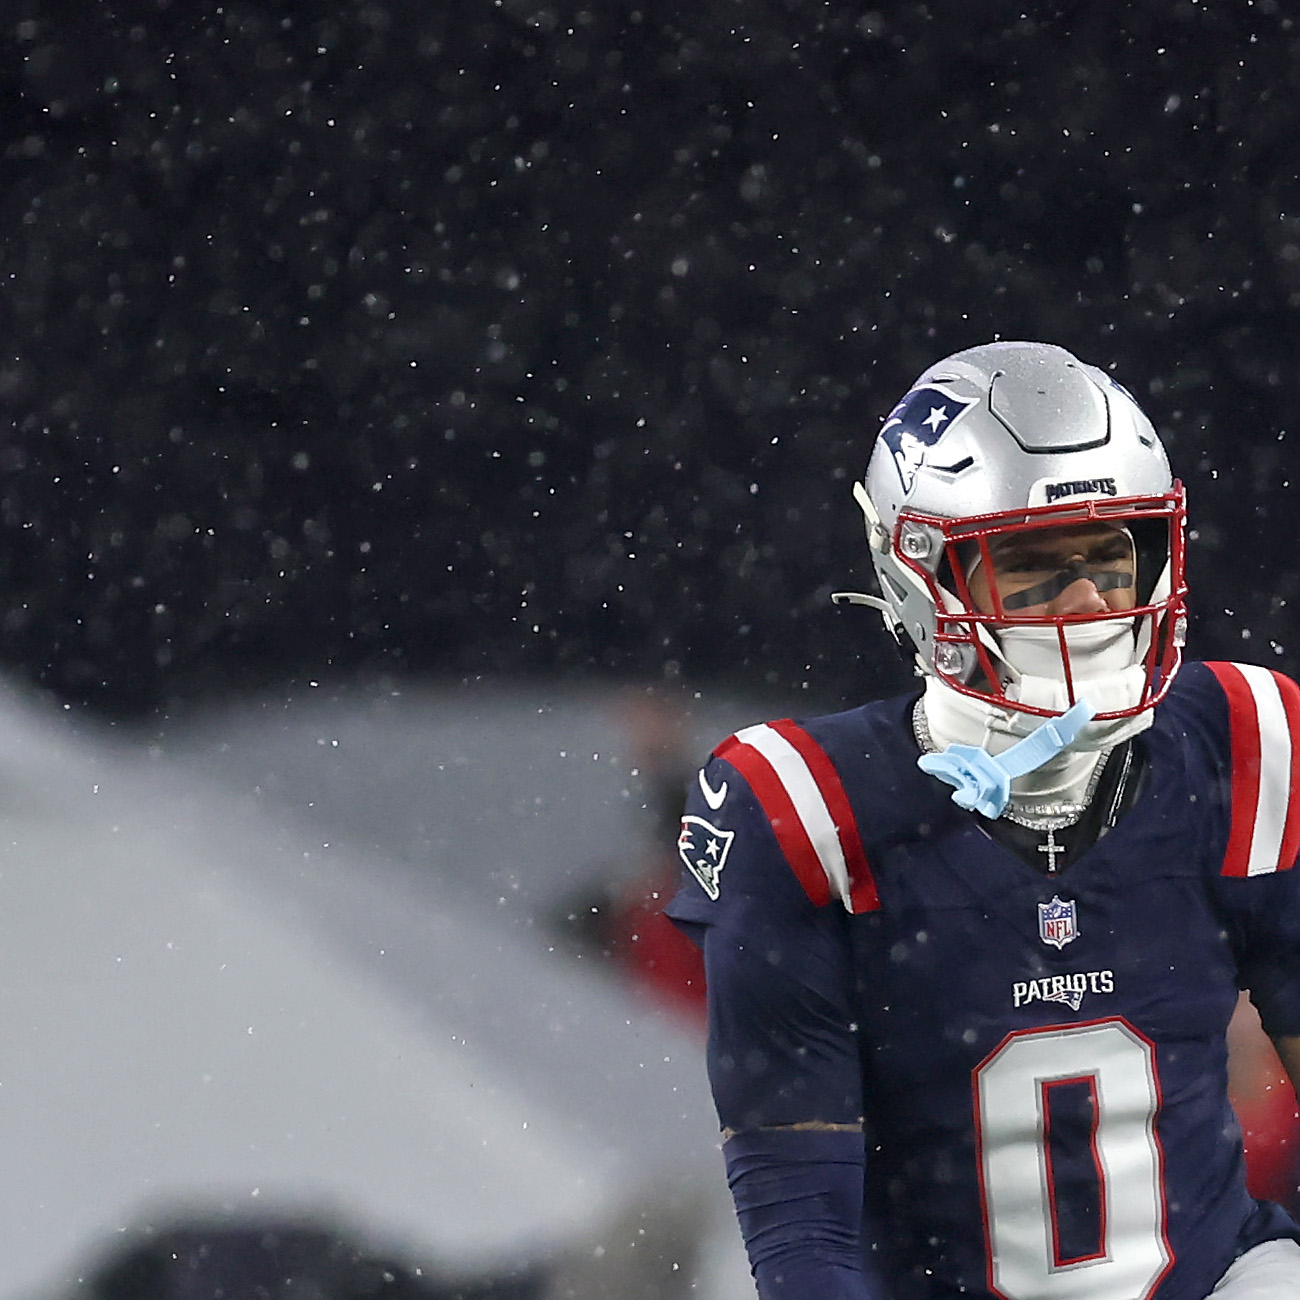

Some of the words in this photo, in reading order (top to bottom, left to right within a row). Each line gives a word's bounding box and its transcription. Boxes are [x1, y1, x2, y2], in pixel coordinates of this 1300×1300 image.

[1045, 478, 1117, 503] PATRIOTS
[1047, 920, 1072, 939] NFL
[1013, 970, 1114, 1008] PATRIOTS
